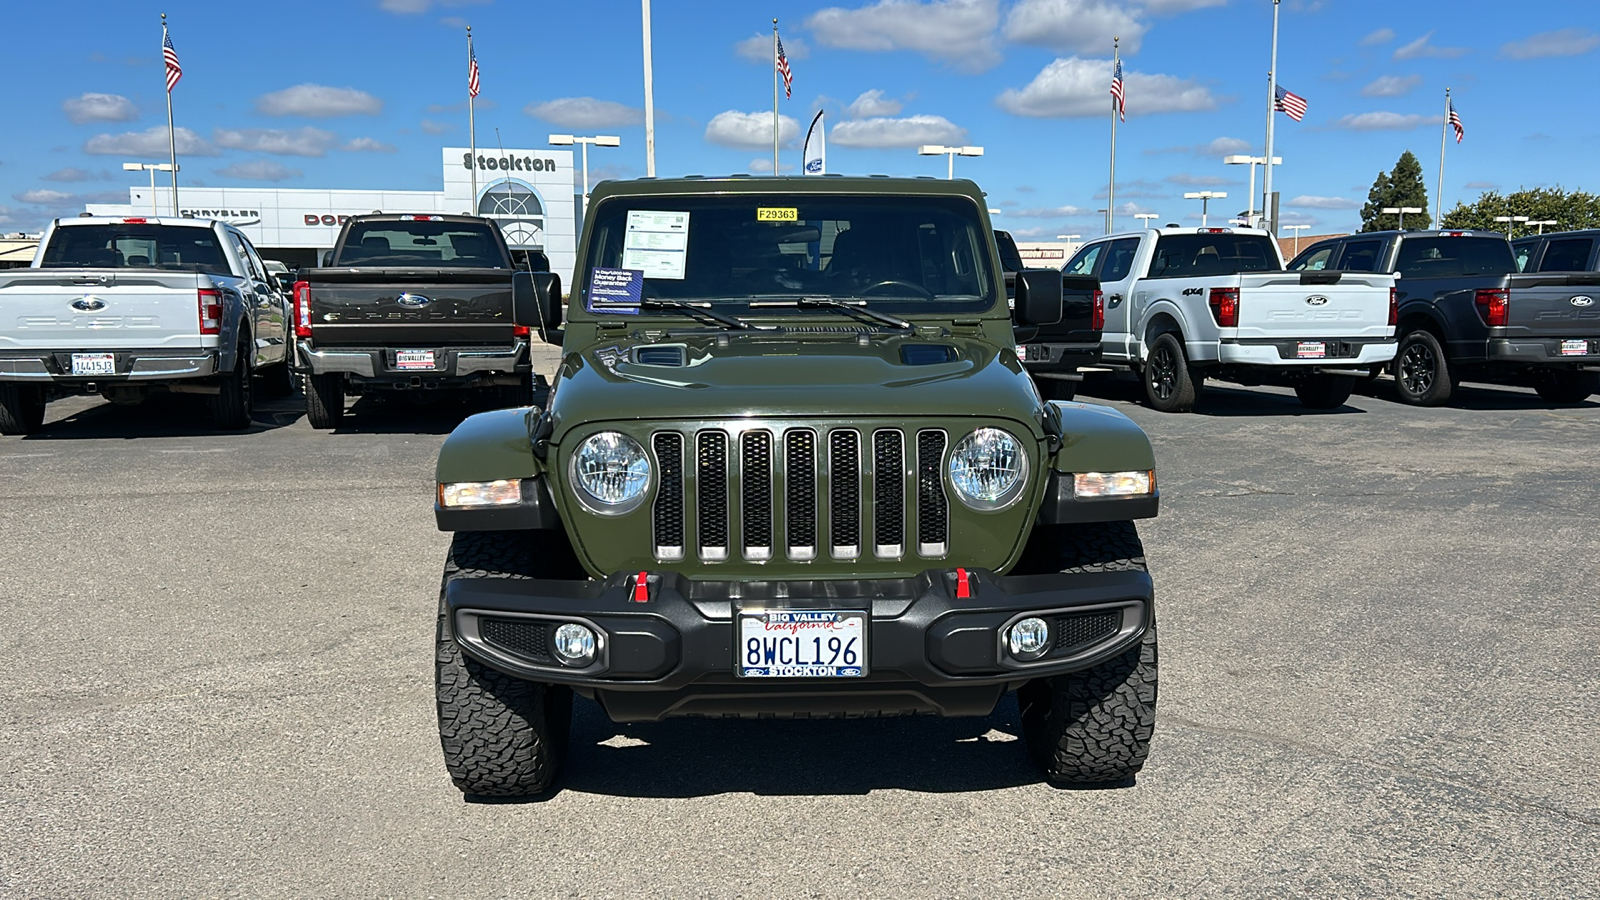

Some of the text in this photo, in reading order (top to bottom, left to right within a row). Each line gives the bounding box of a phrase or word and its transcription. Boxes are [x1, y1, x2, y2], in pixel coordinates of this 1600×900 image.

[463, 153, 556, 172] Stockton
[180, 209, 259, 217] CHRYSLER
[759, 210, 795, 219] F29363
[304, 214, 349, 226] DOD
[1267, 309, 1365, 321] F-150
[1535, 310, 1600, 320] F-15
[76, 361, 113, 371] 14415J3
[769, 613, 836, 622] BIG VALLEY
[764, 621, 843, 635] California
[747, 637, 858, 665] 8WCL196
[768, 666, 837, 676] STOCKTON
